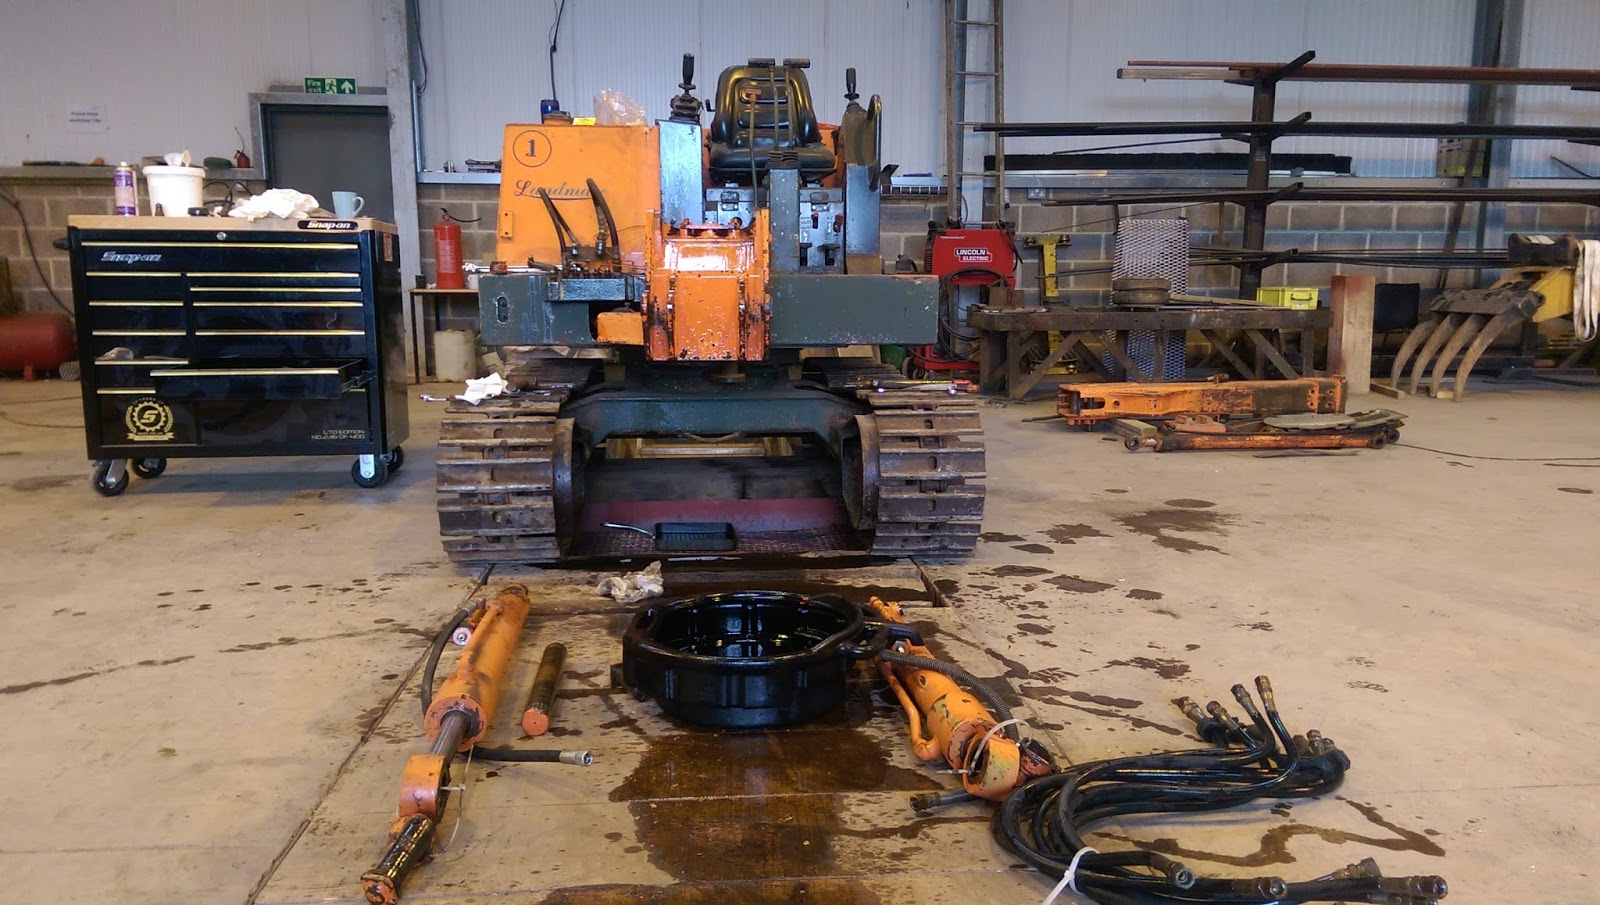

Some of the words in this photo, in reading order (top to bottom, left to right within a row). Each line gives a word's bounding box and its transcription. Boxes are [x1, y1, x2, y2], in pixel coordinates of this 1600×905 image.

[524, 139, 537, 157] 1
[306, 220, 351, 230] Snap-on
[100, 251, 162, 264] Snap-on
